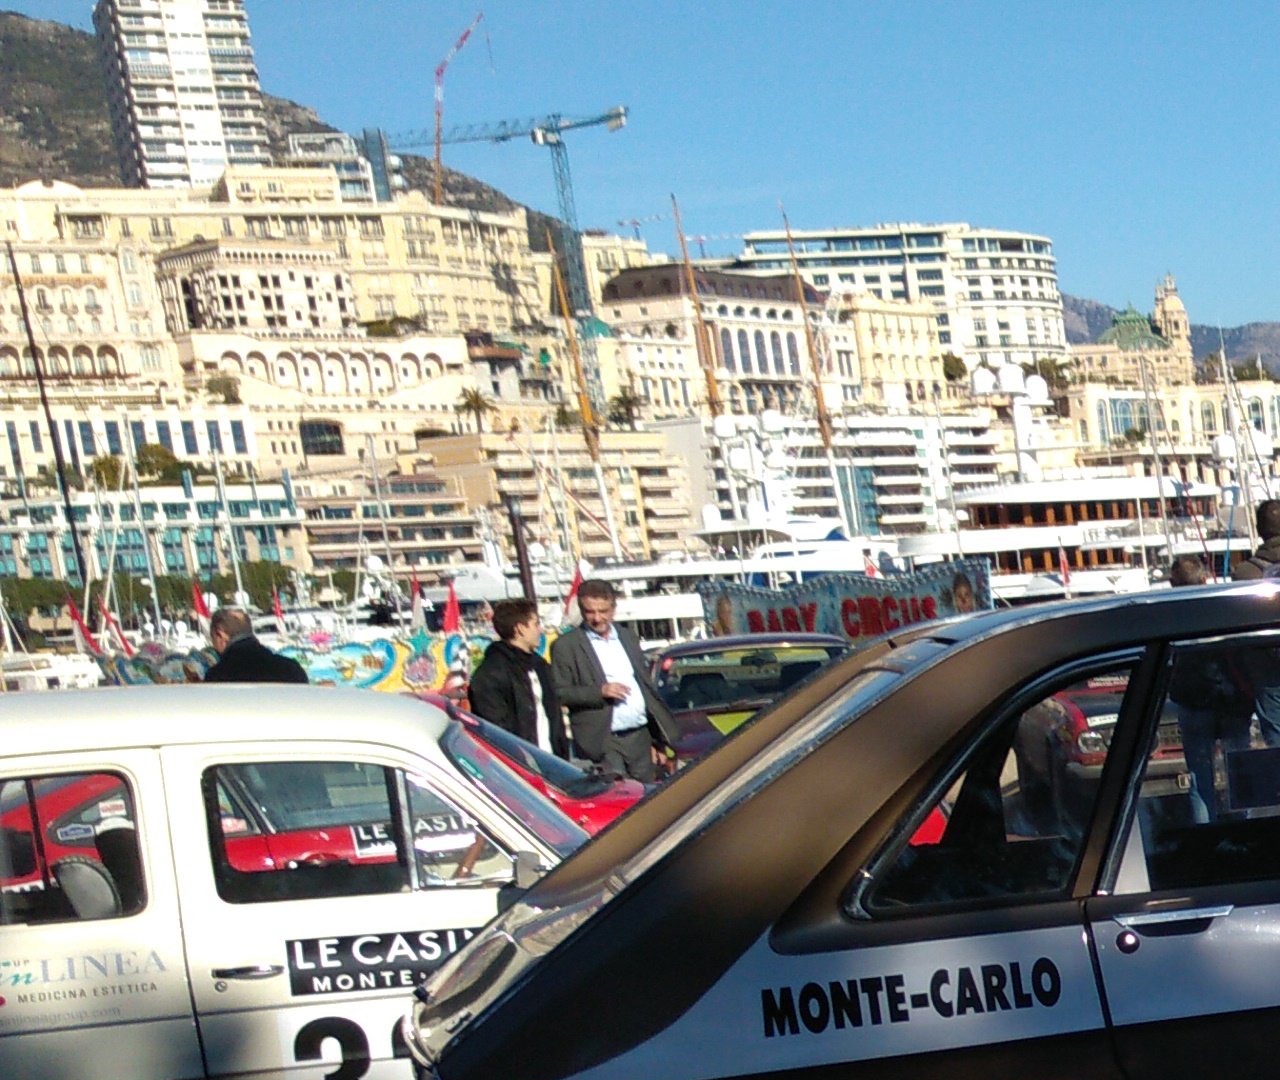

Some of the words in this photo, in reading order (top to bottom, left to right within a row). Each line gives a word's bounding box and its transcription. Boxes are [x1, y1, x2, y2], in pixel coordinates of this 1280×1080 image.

[294, 938, 342, 970] LE
[351, 928, 474, 966] CASI
[18, 989, 87, 1004] MEDICINA
[93, 982, 158, 997] ESTETICA
[761, 957, 1062, 1038] MONTE-CARLO
